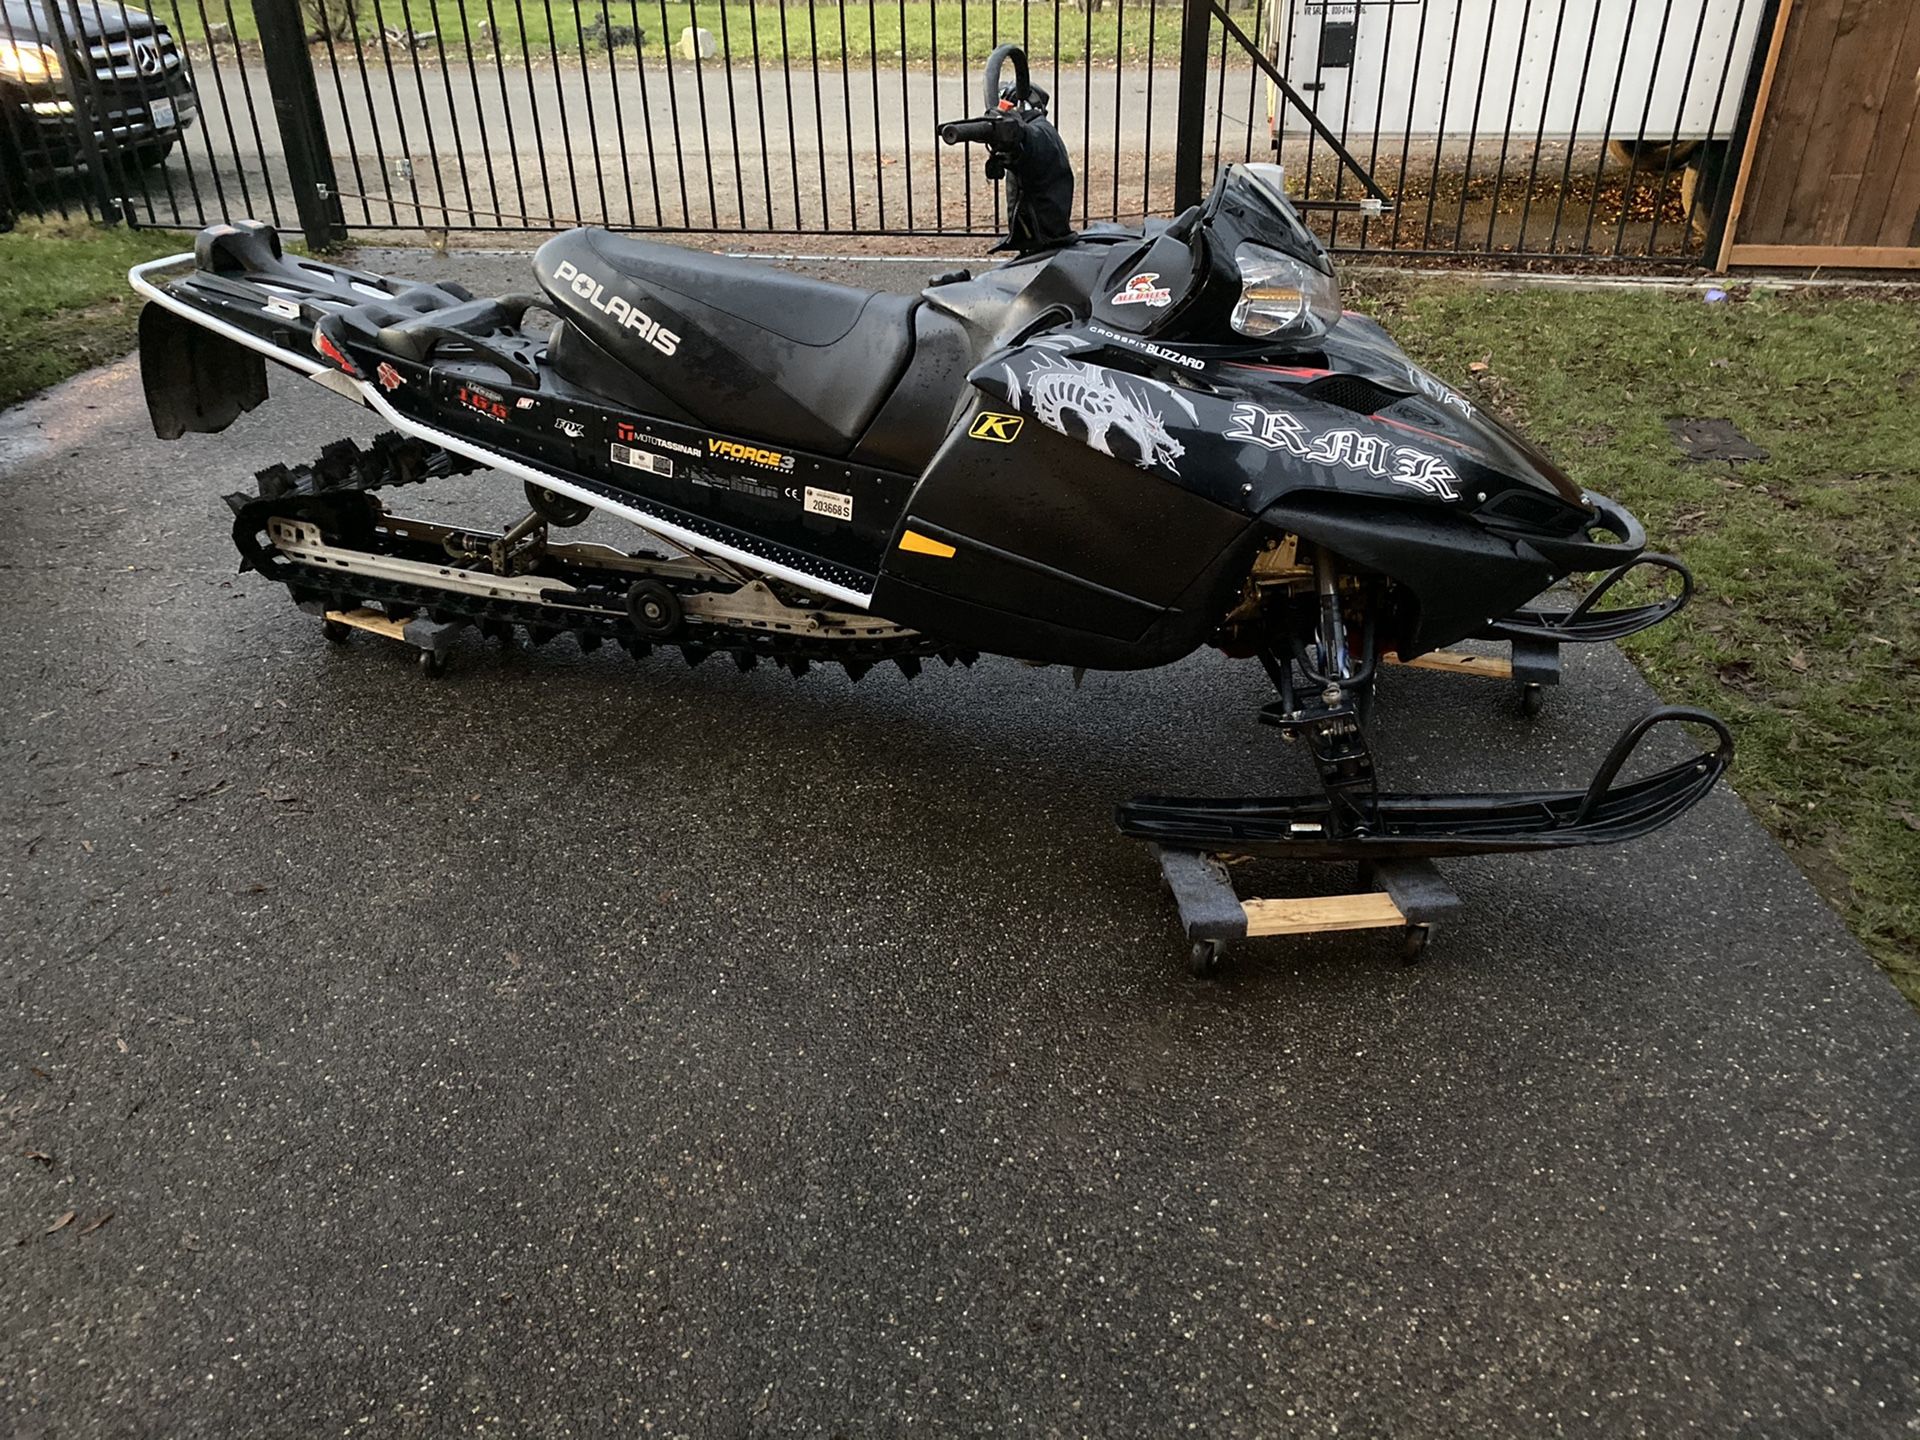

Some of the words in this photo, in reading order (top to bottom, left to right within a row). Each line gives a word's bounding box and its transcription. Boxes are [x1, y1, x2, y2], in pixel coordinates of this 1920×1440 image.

[553, 260, 681, 357] POLARIS
[1114, 293, 1134, 303] ALL
[1135, 290, 1169, 300] BALLS
[1089, 326, 1147, 349] CROSSFIT
[1145, 343, 1206, 370] BLIZZARD
[460, 400, 506, 425] TRACK
[554, 417, 585, 438] FOX
[972, 415, 1021, 440] K
[634, 432, 702, 458] MOTOTASSINARI
[708, 438, 796, 469] VFORCE3
[1221, 402, 1463, 503] RMK
[723, 455, 745, 464] MOTO
[749, 461, 794, 475] TASSINARI
[812, 499, 843, 516] 203668
[843, 506, 850, 517] S
